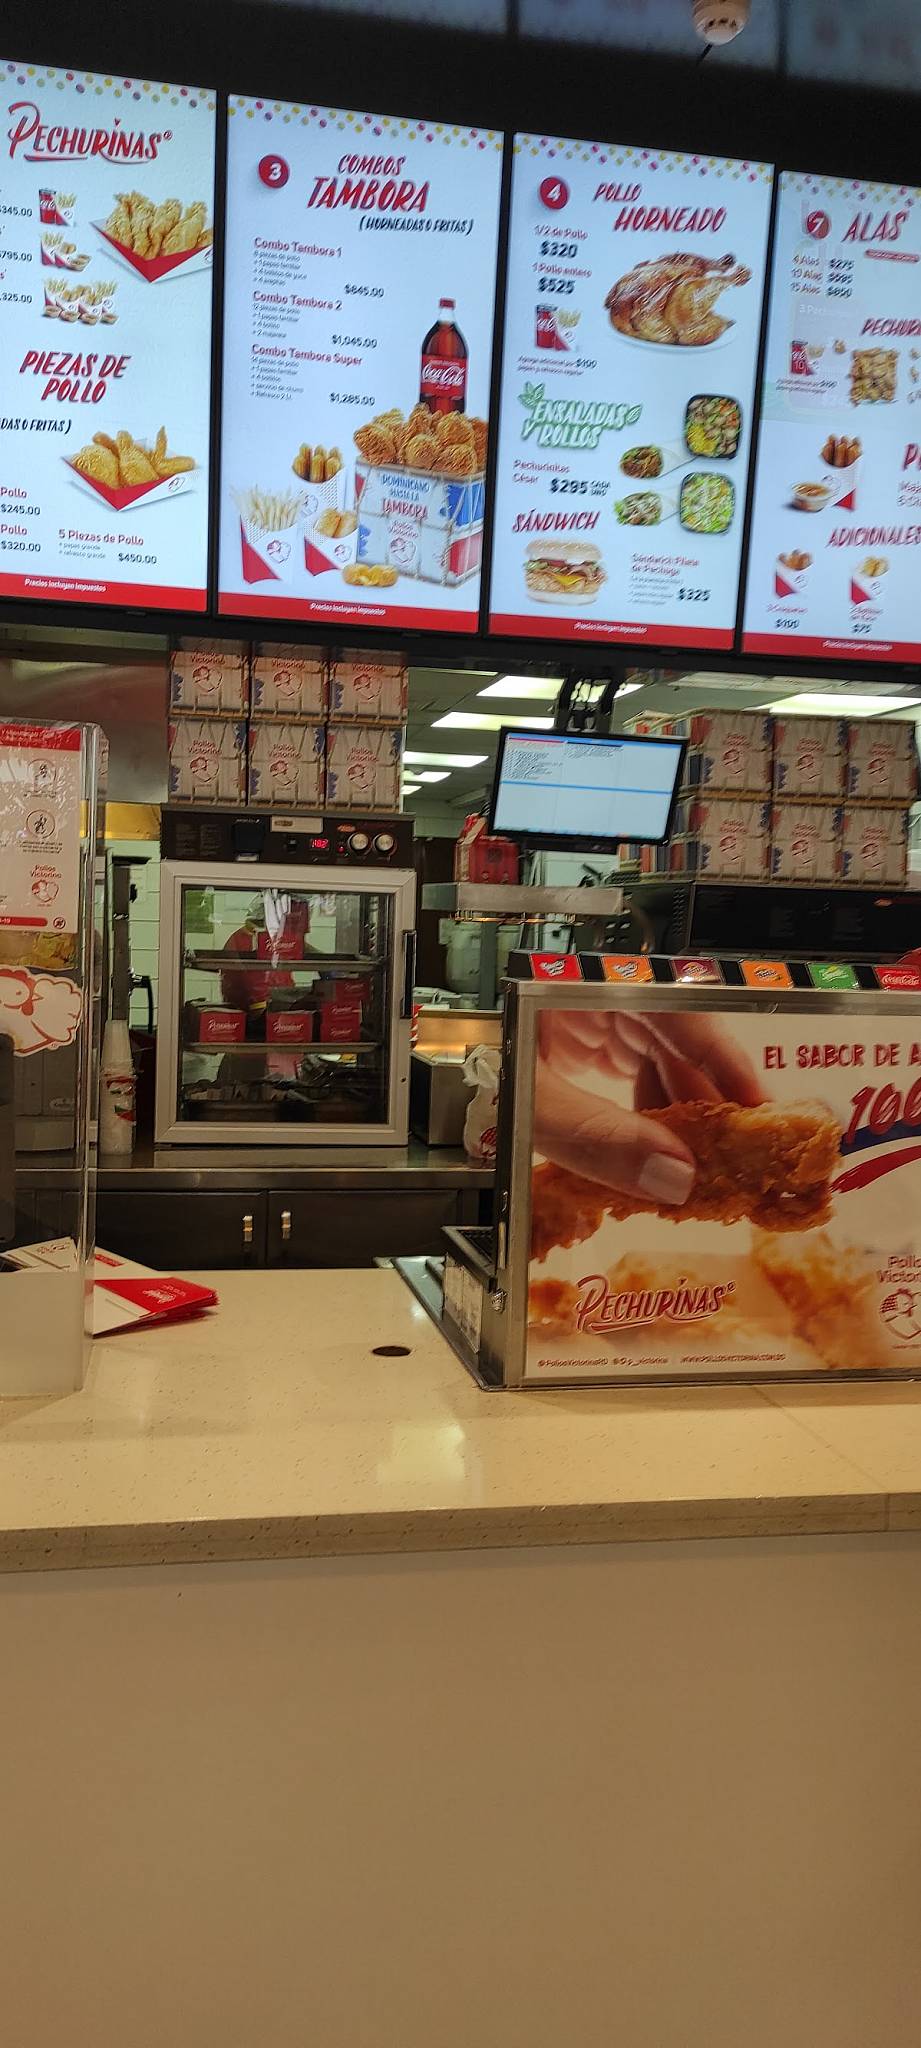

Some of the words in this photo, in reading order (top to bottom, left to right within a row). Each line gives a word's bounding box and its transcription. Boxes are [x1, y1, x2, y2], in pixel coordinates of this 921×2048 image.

[267, 162, 282, 181] 3
[338, 154, 407, 176] COMBOS
[307, 176, 431, 213] TAMBORA
[545, 184, 562, 202] 4
[593, 182, 643, 202] POLLO
[613, 206, 728, 233] HORNEADO
[841, 208, 910, 242] ALAS
[254, 237, 290, 251] Combo
[291, 241, 335, 257] Tambora
[540, 240, 578, 259] $320
[538, 276, 576, 294] $525
[253, 290, 288, 304] Combo
[290, 294, 334, 310] Tambora
[335, 299, 343, 311] 2
[20, 350, 97, 377] PIEZAS
[99, 355, 132, 379] DE
[252, 344, 287, 358] Combo
[288, 347, 332, 362] Tambora
[333, 352, 363, 367] Super
[41, 377, 108, 404] POLLO
[532, 399, 628, 430] ENSALADAS
[537, 422, 602, 448] ROLLOS
[0, 486, 28, 499] Pollo
[1, 503, 41, 516] $245.00
[0, 523, 28, 536] Pollo
[512, 508, 601, 533] SÁNDWICH
[0, 540, 41, 552] $320.00
[59, 529, 65, 539] 5
[68, 529, 101, 542] Piezas
[103, 533, 116, 543] de
[118, 534, 144, 546] Pollo
[118, 552, 157, 564] $450.00
[679, 587, 711, 602] $325
[763, 1045, 787, 1069] EL
[797, 1043, 866, 1068] SABOR
[873, 1042, 902, 1067] DE
